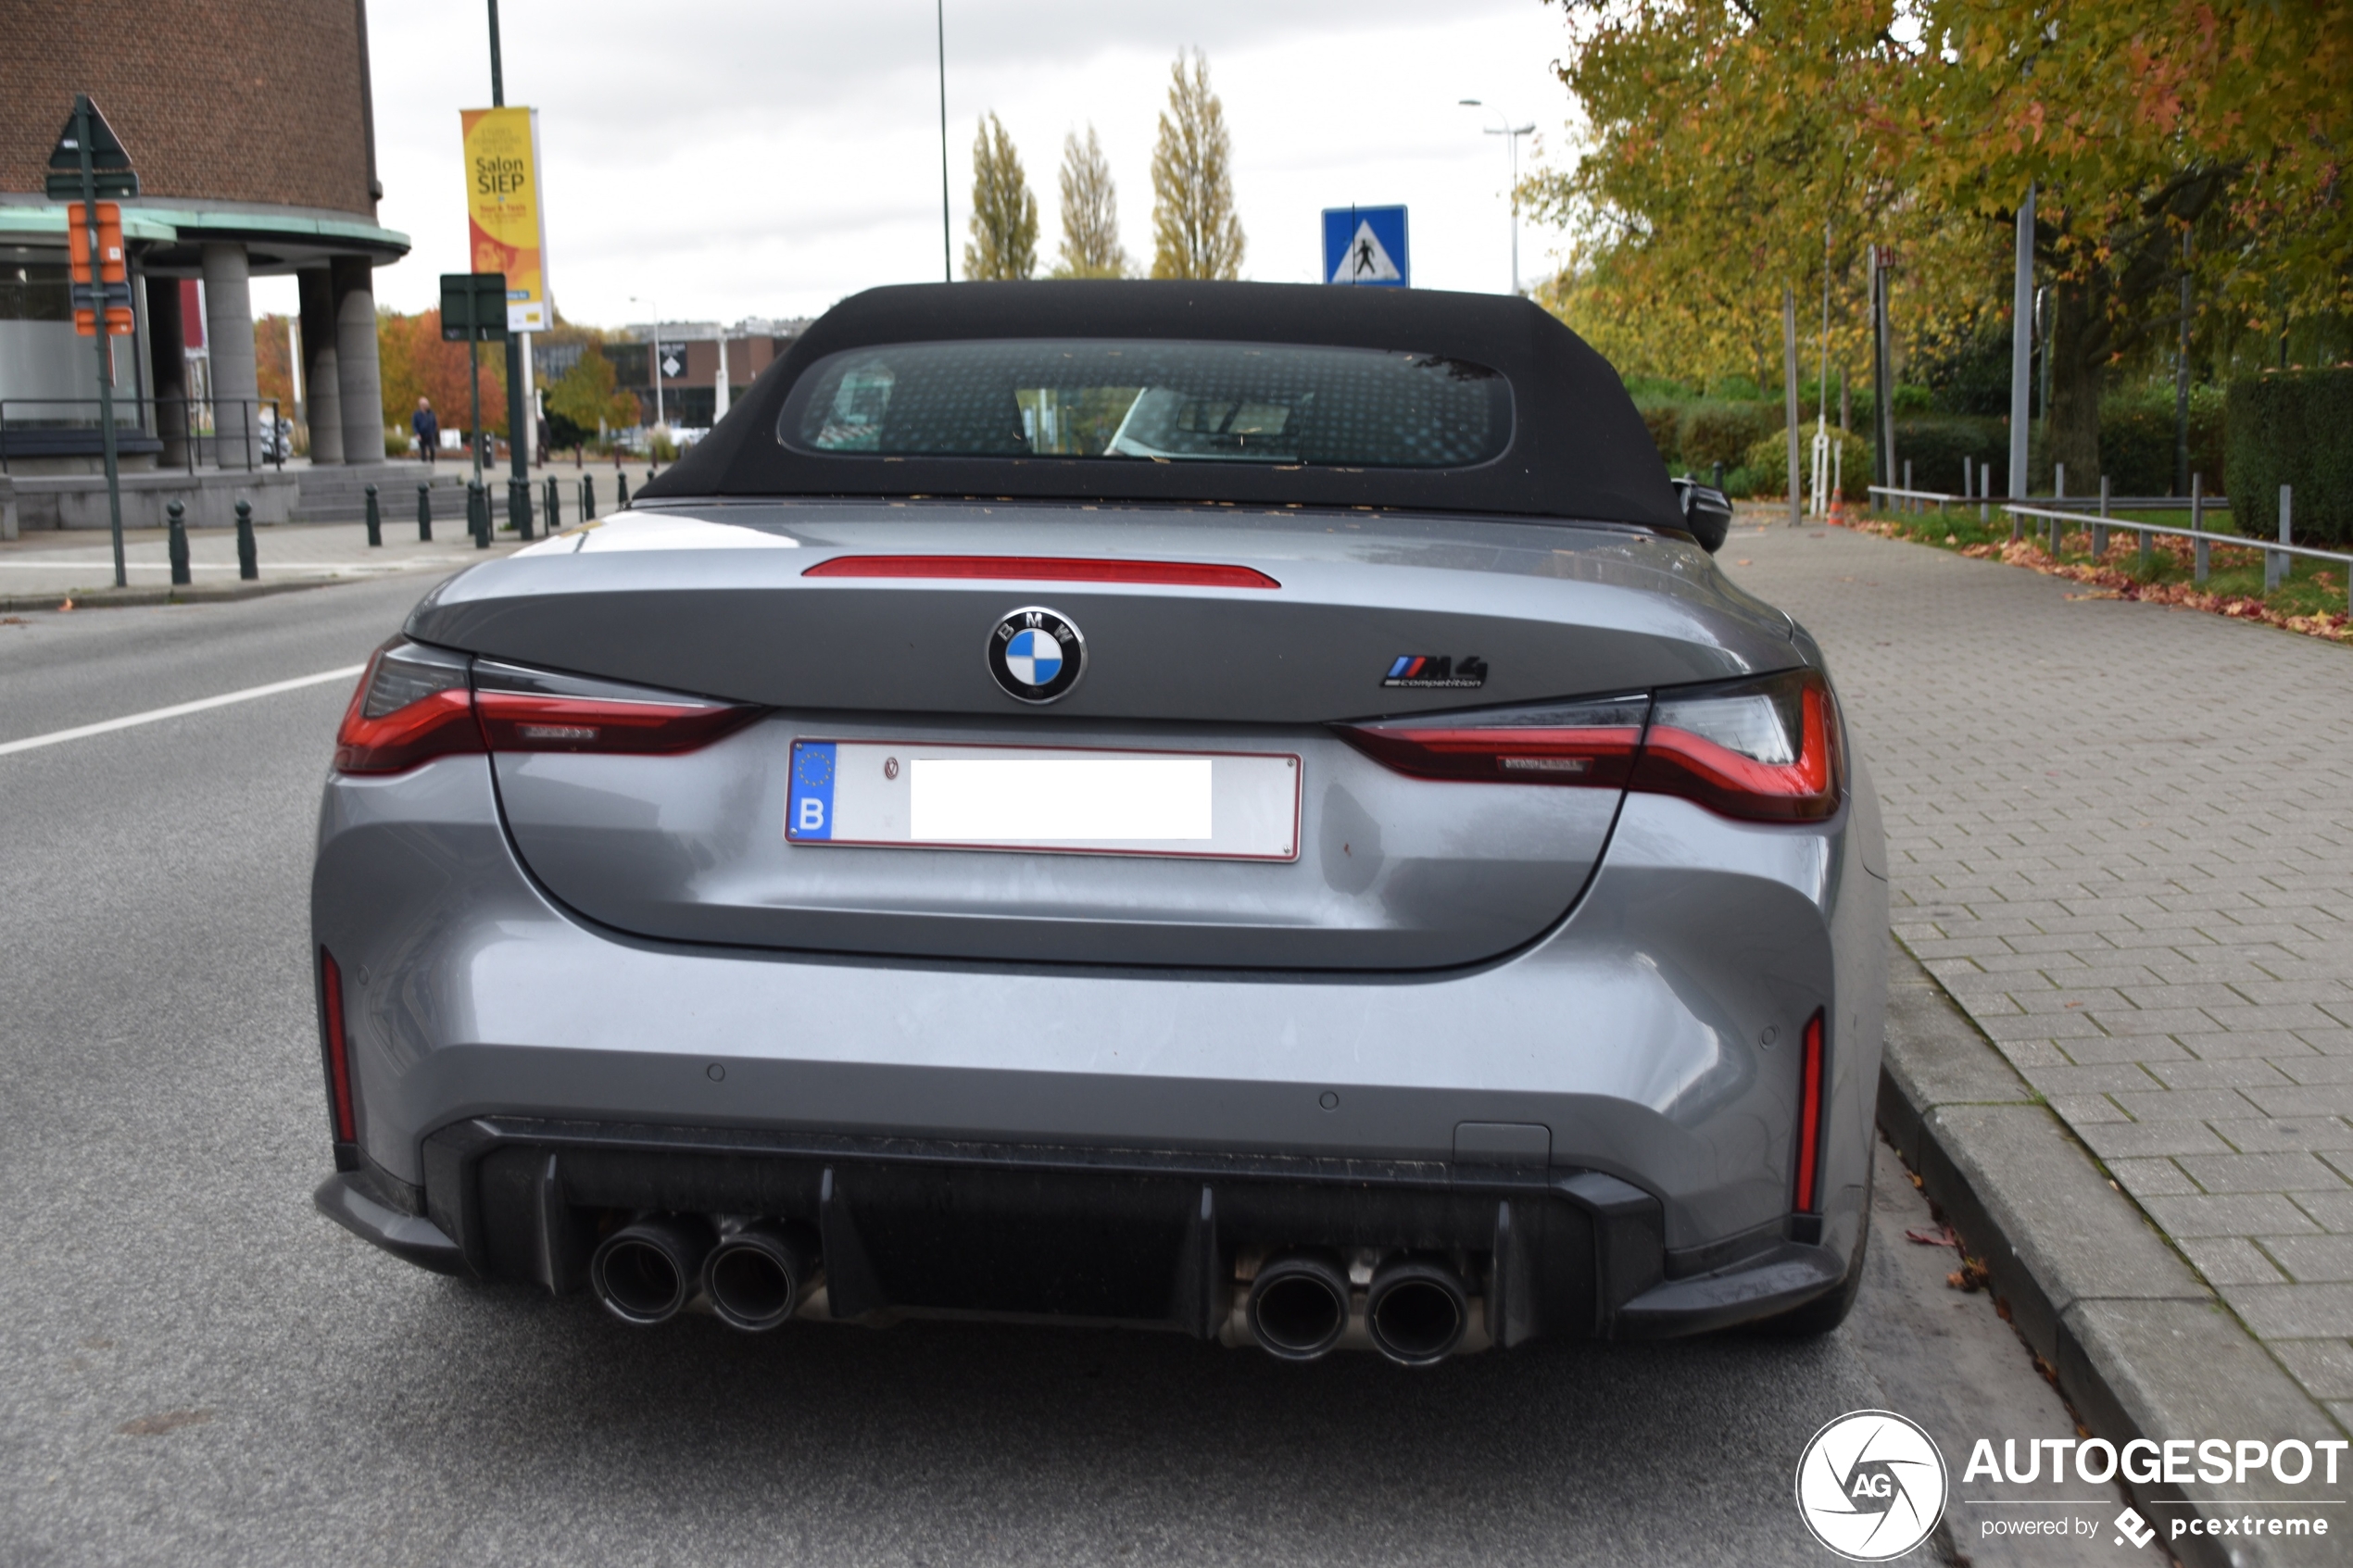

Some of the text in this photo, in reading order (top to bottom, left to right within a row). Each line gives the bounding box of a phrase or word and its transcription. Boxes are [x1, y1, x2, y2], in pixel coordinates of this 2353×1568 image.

[476, 156, 523, 174] Salon
[478, 173, 524, 195] SIEP
[997, 611, 1075, 645] BMW
[1414, 655, 1489, 679] M4
[1400, 679, 1482, 688] competition
[799, 797, 824, 831] B
